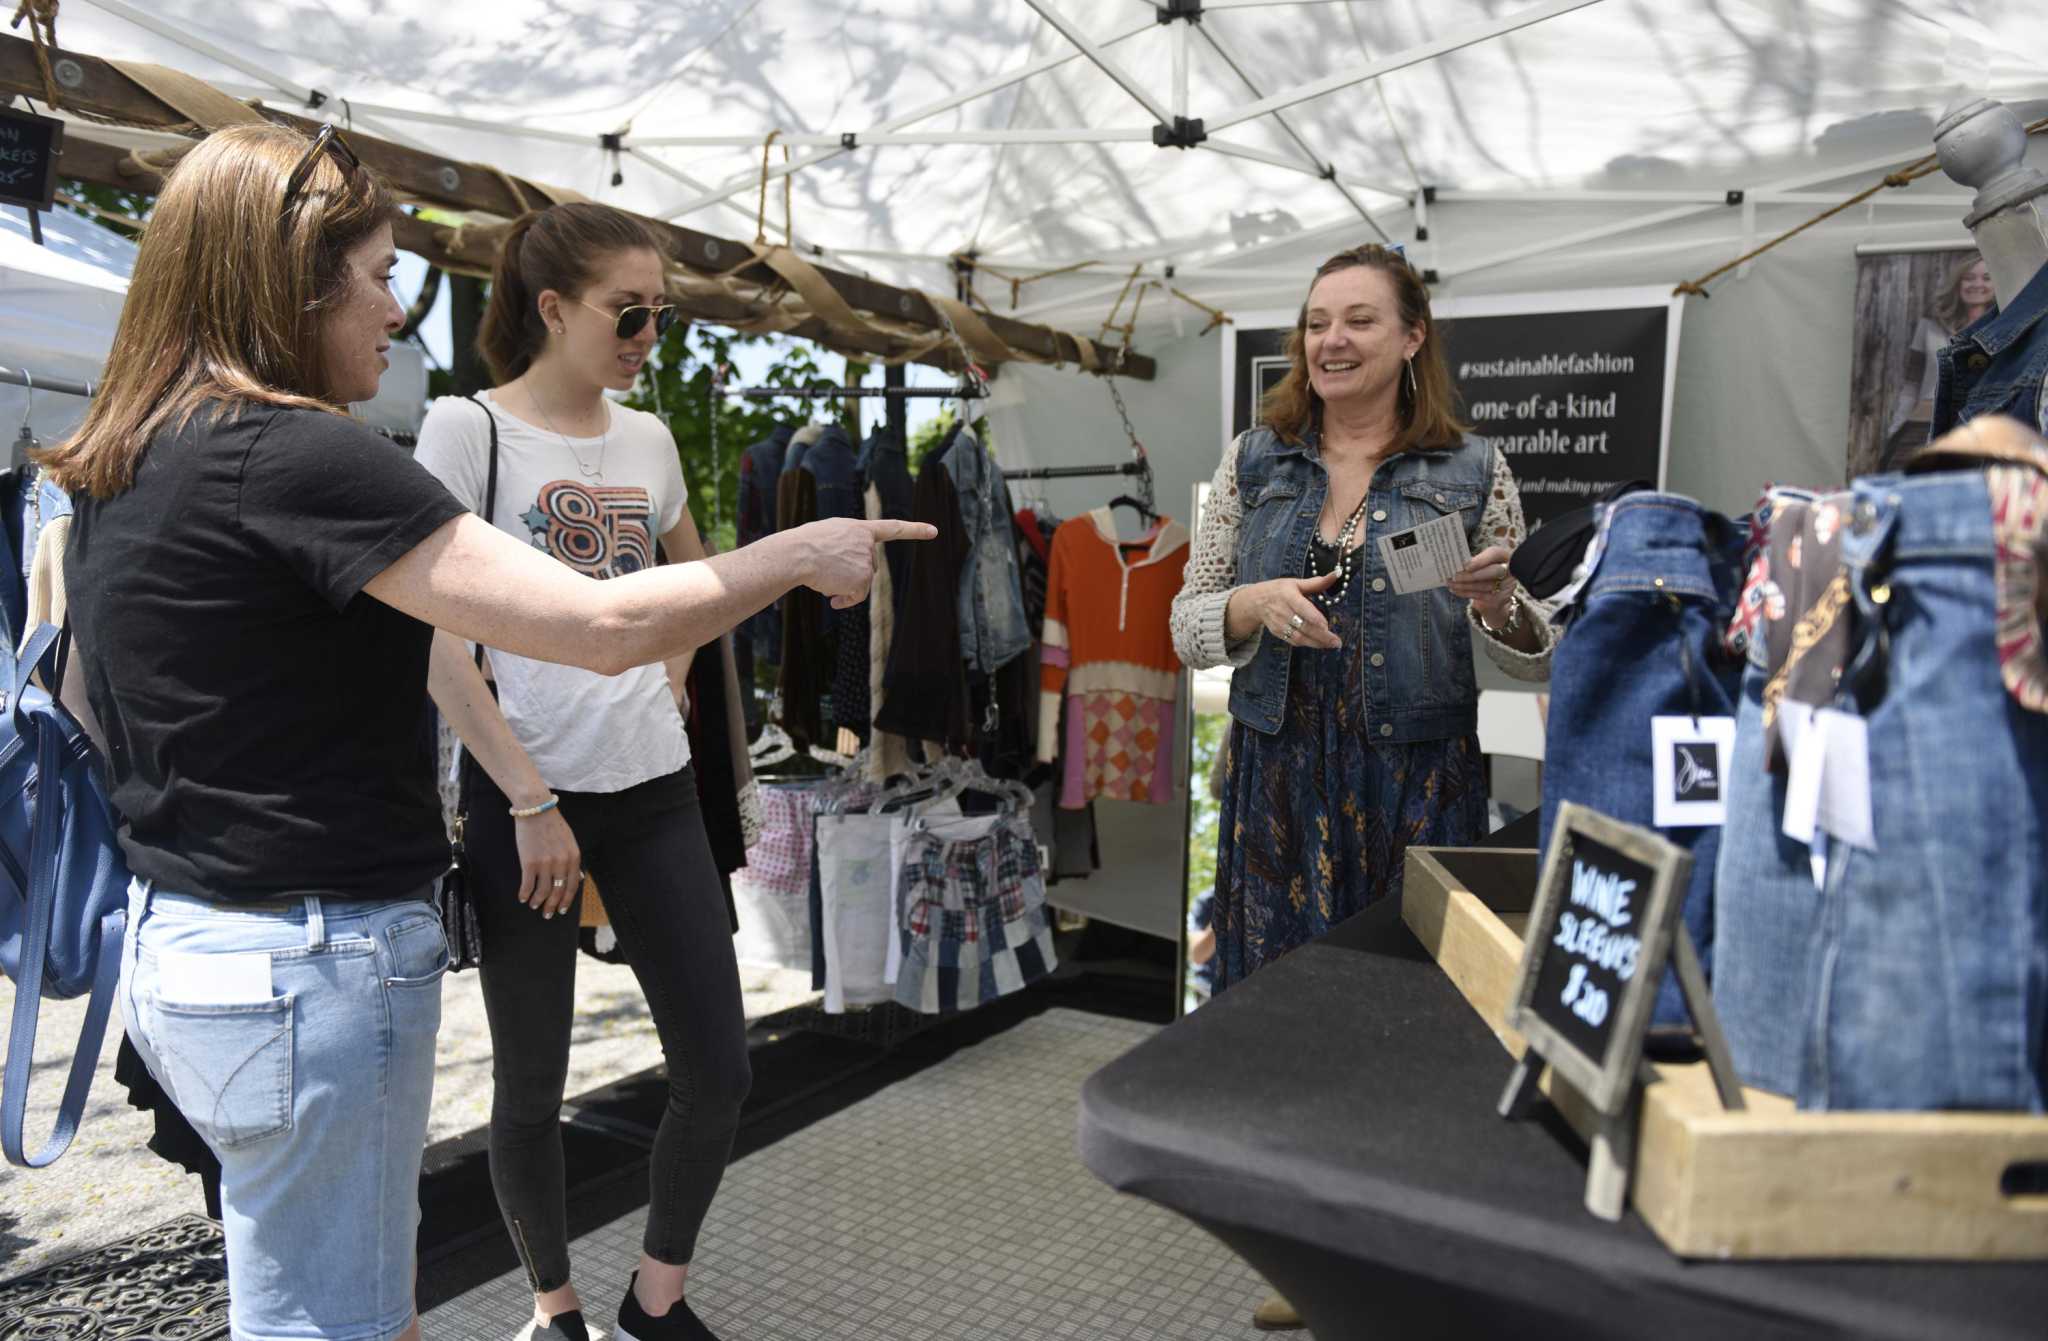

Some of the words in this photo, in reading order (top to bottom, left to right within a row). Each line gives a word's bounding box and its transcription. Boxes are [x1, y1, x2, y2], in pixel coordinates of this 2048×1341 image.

[1459, 352, 1635, 380] #sustainablefashion
[1471, 391, 1617, 420] one-of-a-kind
[1573, 430, 1610, 454] art
[1522, 478, 1547, 493] and
[1547, 478, 1592, 497] making
[1570, 859, 1638, 928] WINE
